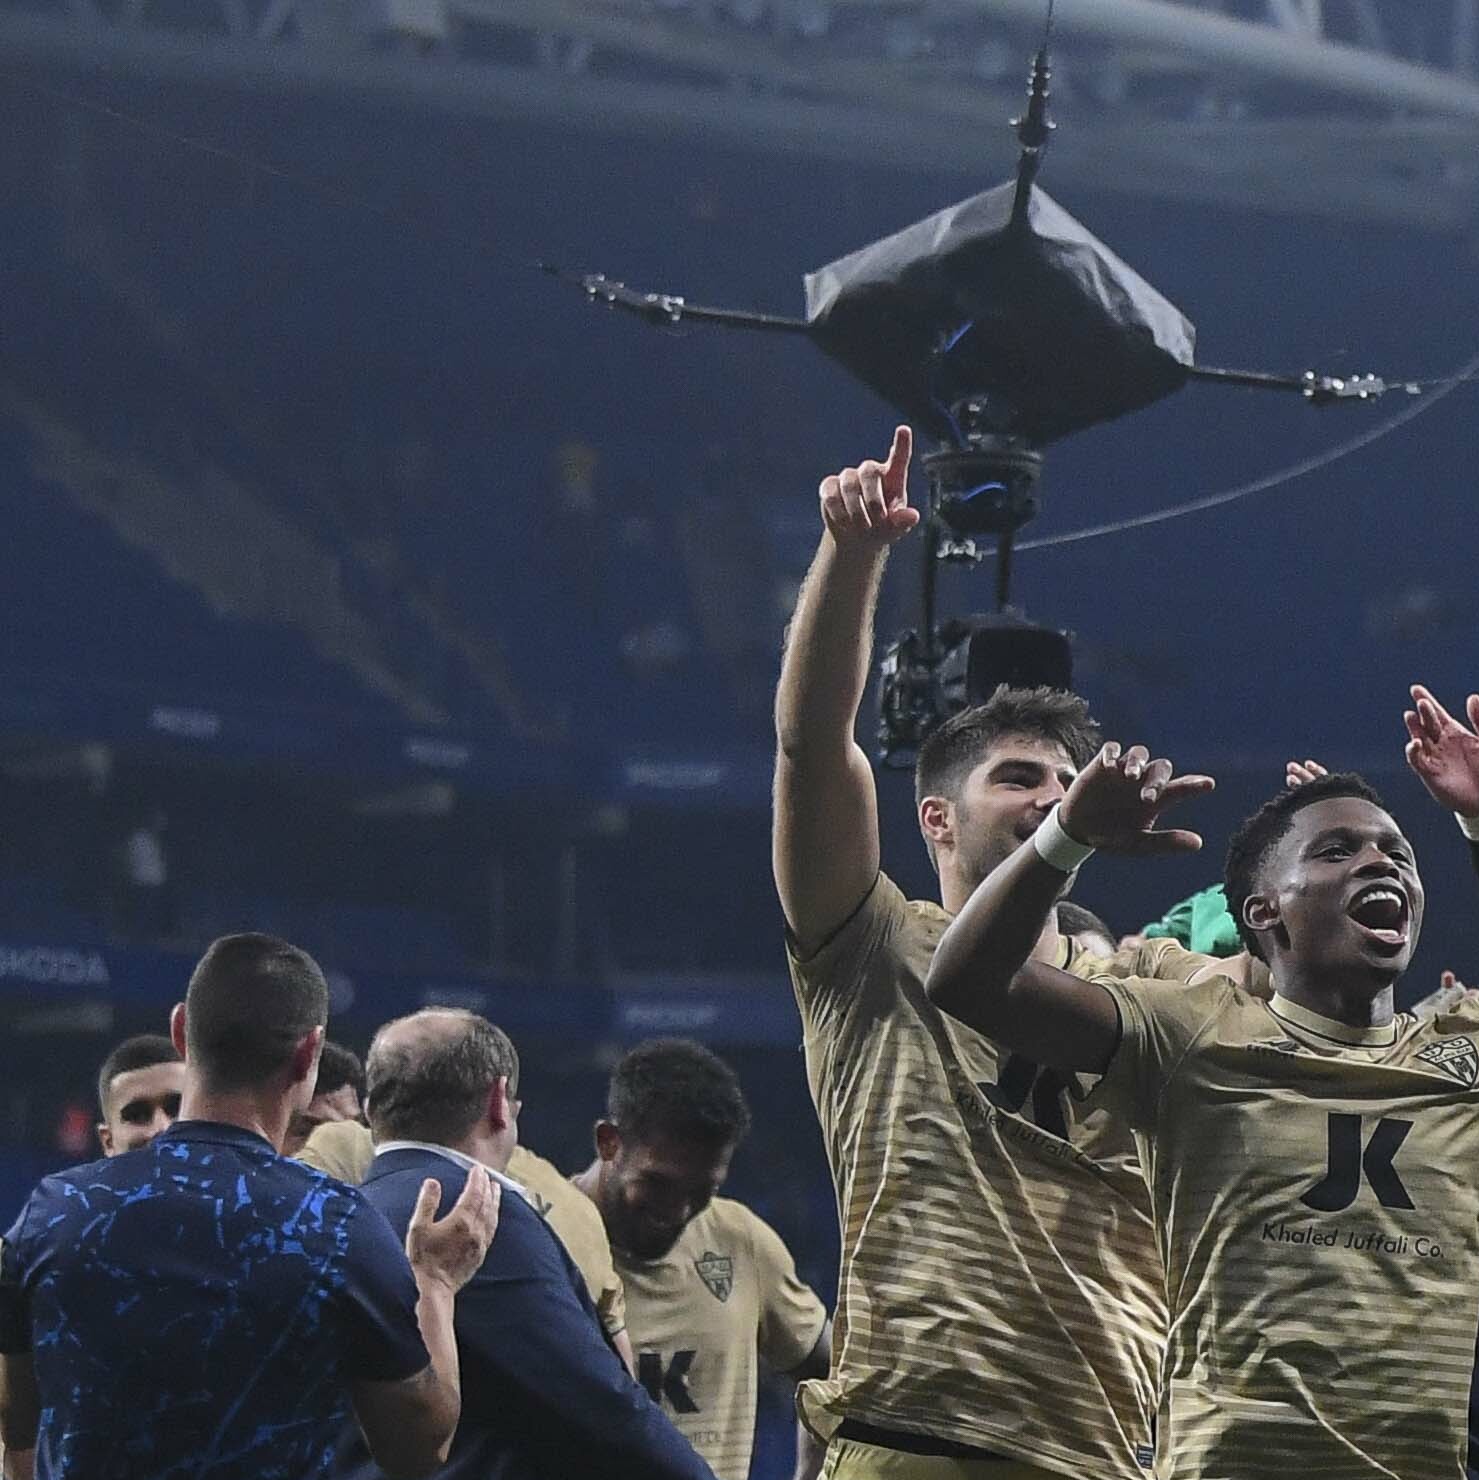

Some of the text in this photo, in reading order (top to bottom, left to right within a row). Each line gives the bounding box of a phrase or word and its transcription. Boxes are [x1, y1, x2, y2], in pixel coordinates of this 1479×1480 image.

[0, 945, 110, 984] KODA
[1299, 1112, 1416, 1213] JK
[1261, 1222, 1445, 1259] Khaled Juffali Co.
